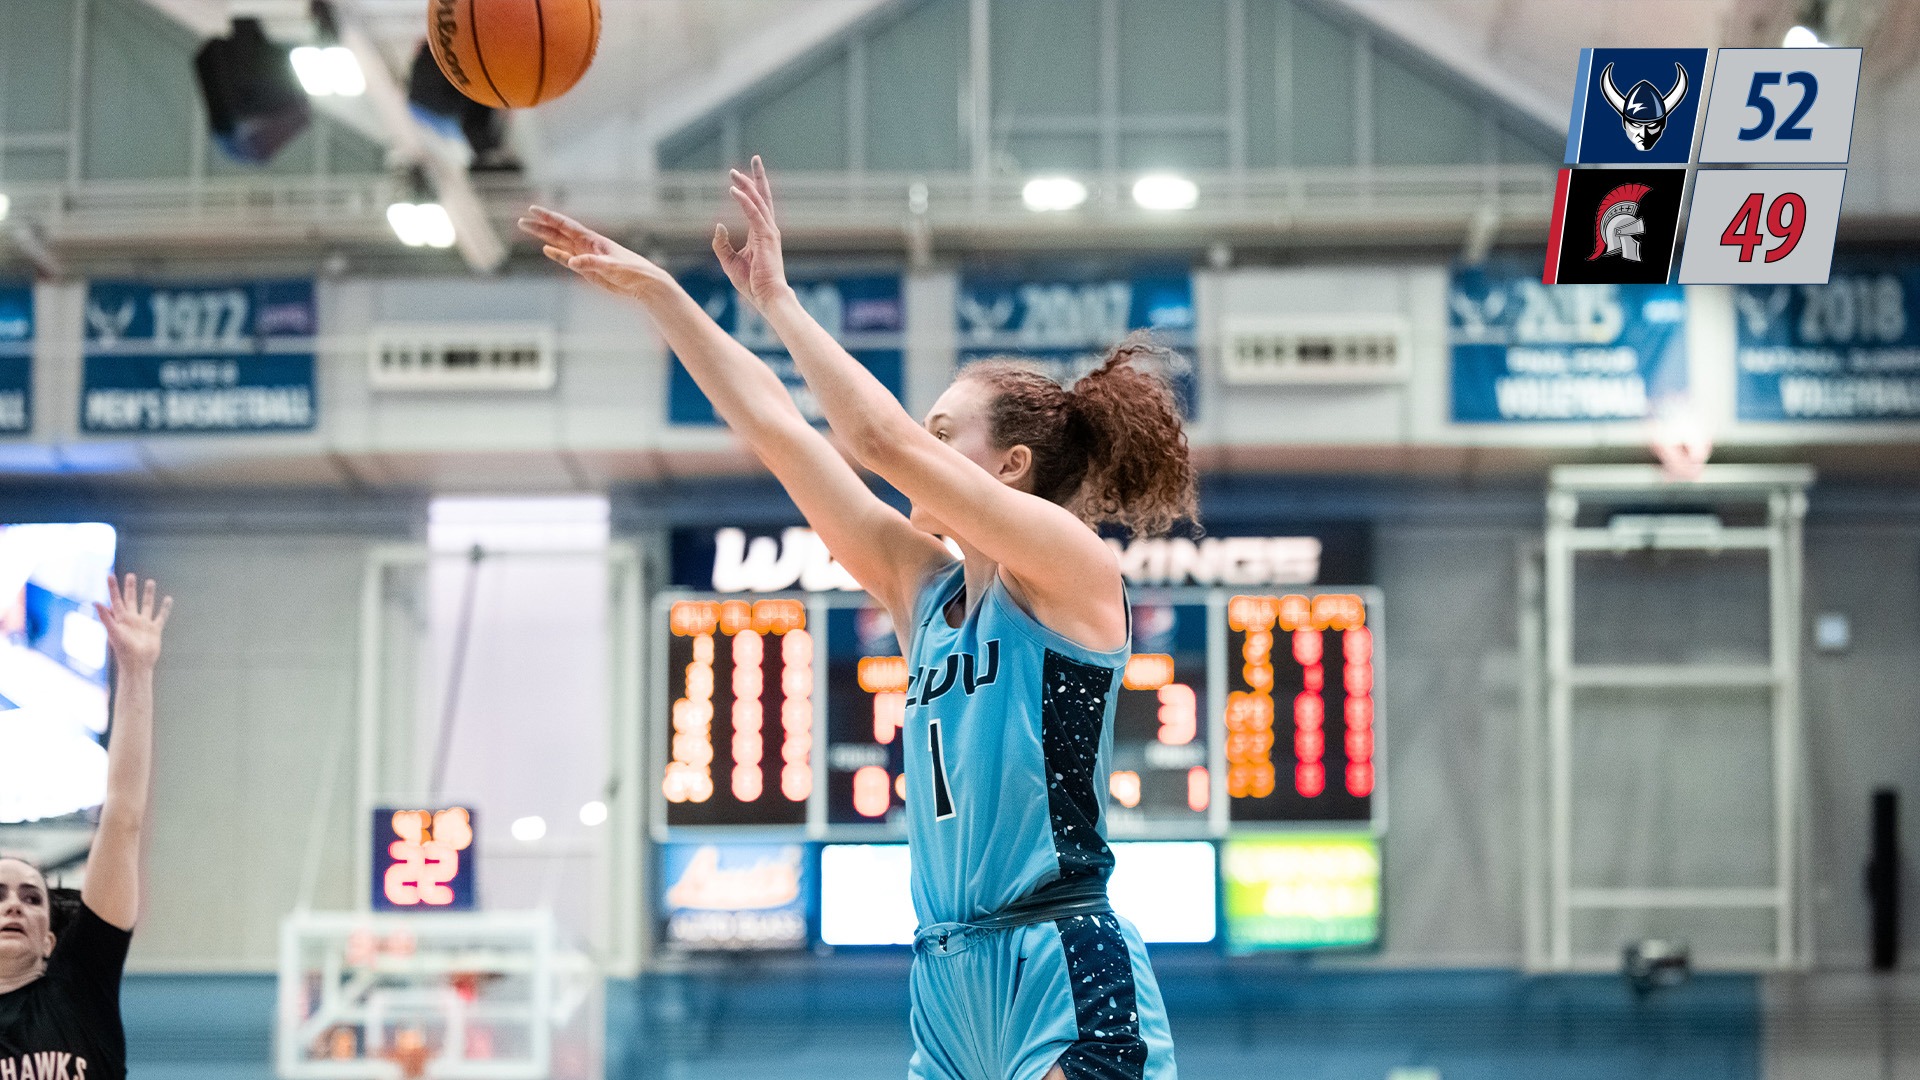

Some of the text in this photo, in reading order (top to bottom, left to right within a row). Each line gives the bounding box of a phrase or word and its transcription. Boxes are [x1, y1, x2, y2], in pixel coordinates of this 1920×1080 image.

[436, 0, 471, 85] ilson
[928, 718, 956, 822] 1
[0, 1051, 87, 1080] HAWKS
